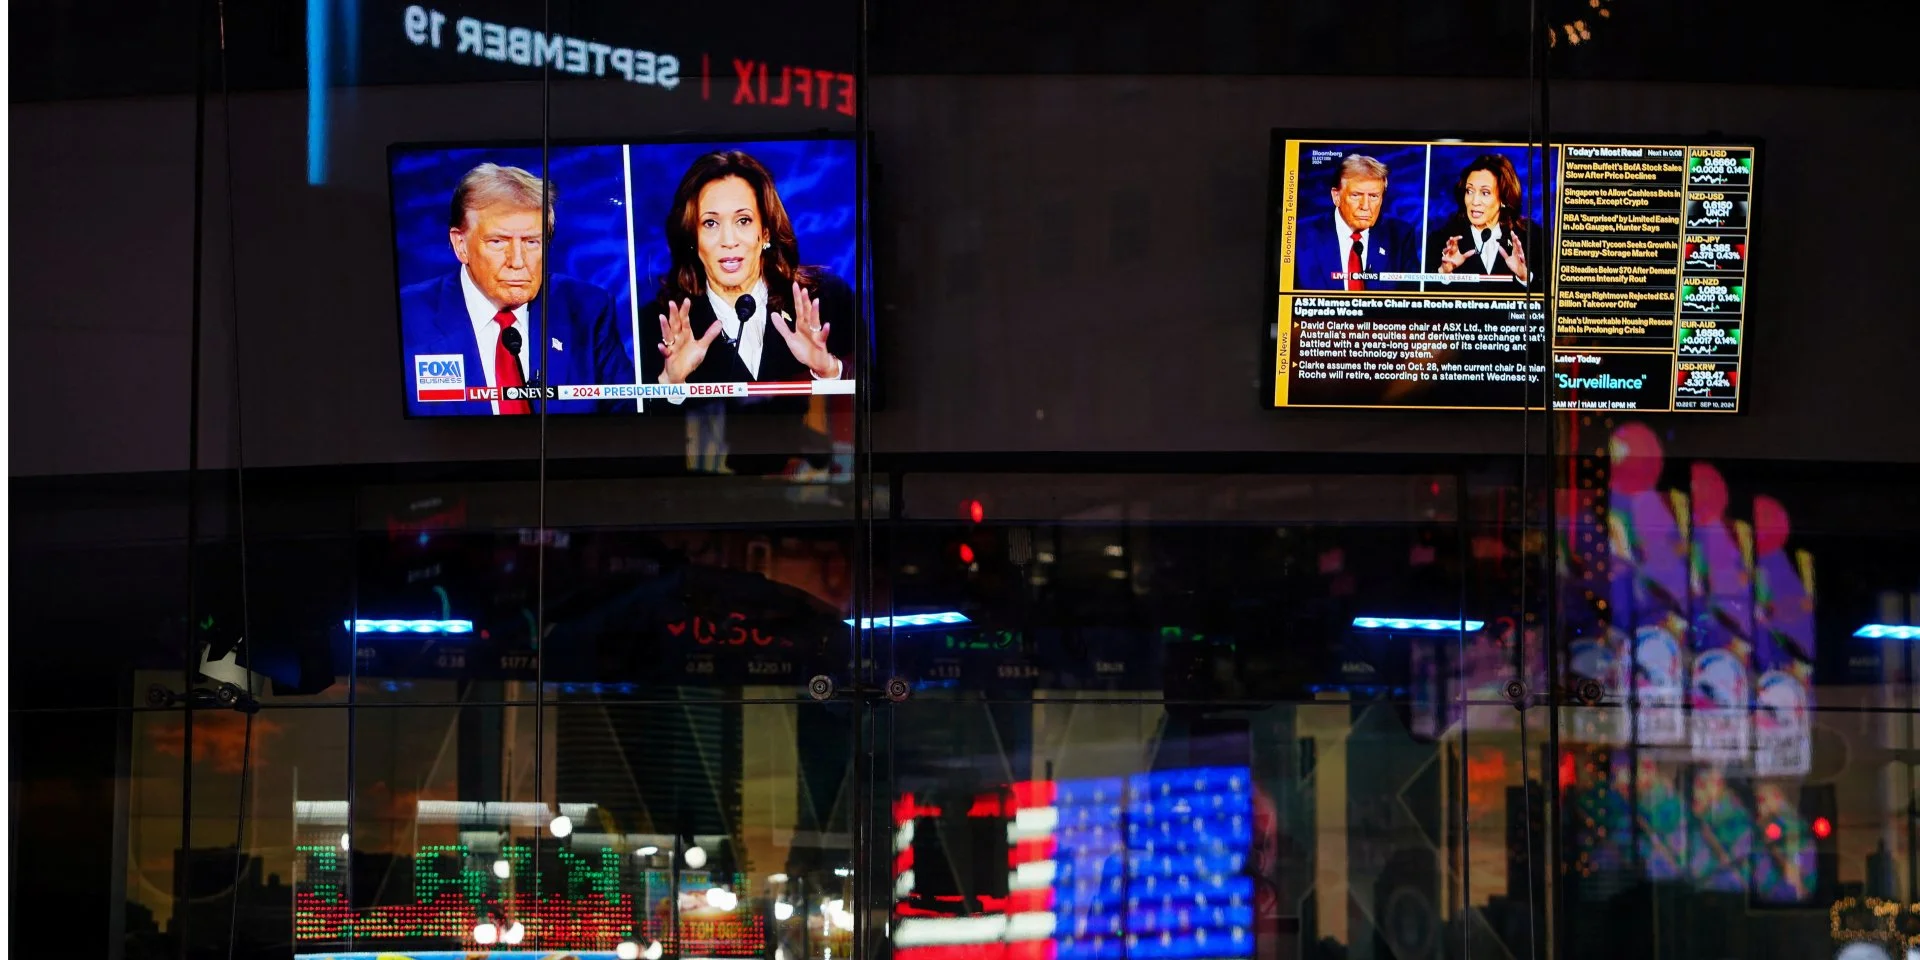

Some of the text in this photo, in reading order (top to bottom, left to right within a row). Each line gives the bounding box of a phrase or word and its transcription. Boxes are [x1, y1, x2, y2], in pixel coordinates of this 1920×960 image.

[1568, 147, 1642, 158] Today's Most Read
[1566, 162, 1682, 172] Warren Buffett's BofA Stock Sales
[1566, 170, 1585, 178] Slow
[1585, 171, 1604, 179] After
[1624, 172, 1656, 180] Declines
[1565, 188, 1600, 198] Singapore
[1608, 189, 1626, 197] Allow
[1627, 189, 1658, 197] Cashless
[1689, 193, 1724, 201] NZD-USD
[1565, 197, 1648, 207] Casinos, Except Crypto
[1702, 201, 1733, 210] 0.6150
[1284, 170, 1295, 264] Bloomberg Television
[1705, 209, 1730, 217] UNCH
[1563, 213, 1579, 221] RBA
[1619, 215, 1628, 223] by
[1628, 215, 1656, 223] Limited
[1656, 215, 1680, 224] Easing
[1571, 222, 1660, 232] Job Gauges, Hunter Says
[1562, 240, 1671, 249] China Nickel Tycoon Seeks Growth
[1562, 248, 1573, 256] US
[1573, 248, 1630, 258] Energy-Storage
[1561, 265, 1570, 273] Oil
[1570, 265, 1599, 273] Steadies
[1599, 266, 1619, 274] Below
[1619, 266, 1632, 274] $70
[1650, 267, 1677, 275] Demand
[1560, 274, 1647, 284] Concerns Intensify Rout
[1684, 278, 1719, 286] AUD-NZD
[1559, 291, 1659, 301] REA Says Rightmove Rejected
[1295, 298, 1317, 307] ASX
[1318, 299, 1351, 307] Names
[1351, 299, 1383, 308] Clarke
[1384, 300, 1411, 308] Chair
[1423, 300, 1454, 309] Roche
[1455, 300, 1489, 309] Retires
[1490, 301, 1516, 310] Amid
[1559, 299, 1637, 309] Billion Takeover Offer
[1295, 307, 1363, 317] Upgrade Woes
[1301, 321, 1324, 330] David
[1326, 321, 1355, 330] Clarke
[1357, 322, 1371, 330] will
[1373, 322, 1406, 331] become
[1409, 322, 1430, 331] chair
[1432, 324, 1441, 332] at
[1443, 323, 1462, 332] ASX
[1484, 323, 1498, 332] the
[1558, 316, 1673, 327] China's Unworkable Housing Rescue
[1681, 321, 1716, 329] EUR-AUD
[1558, 325, 1645, 335] Math Prolonging Crisis
[1300, 331, 1520, 343] Australia's main equities and derivatives exchange
[1300, 339, 1331, 348] battled
[1333, 340, 1351, 348] with
[1362, 341, 1409, 351] years-long
[1411, 342, 1448, 351] upgrade
[1450, 341, 1460, 350] of
[1462, 342, 1473, 350] its
[1475, 342, 1510, 352] clearing
[1279, 332, 1289, 376] Top News
[1300, 348, 1434, 360] settlement technology system.
[1555, 354, 1602, 365] Later Today
[419, 361, 452, 377] FOX
[1299, 360, 1325, 369] Clarke
[1363, 361, 1377, 370] the
[1378, 361, 1393, 370] role
[1396, 363, 1406, 371] on
[1408, 362, 1425, 371] Oct.
[1426, 362, 1439, 372] 28,
[1441, 363, 1462, 371] when
[1464, 363, 1493, 372] current
[1495, 363, 1514, 372] chair
[1678, 363, 1715, 371] USD-KRW
[1299, 370, 1327, 379] Roche
[1329, 371, 1344, 379] will
[1346, 371, 1372, 381] retire,
[1374, 371, 1418, 381] according
[1440, 373, 1484, 381] statement
[1554, 373, 1647, 390] "Surveillance"
[469, 388, 498, 400] LIVE
[573, 387, 601, 397] 2024
[604, 386, 685, 396] PRESIDENTIAL
[690, 385, 734, 395] DEBATE
